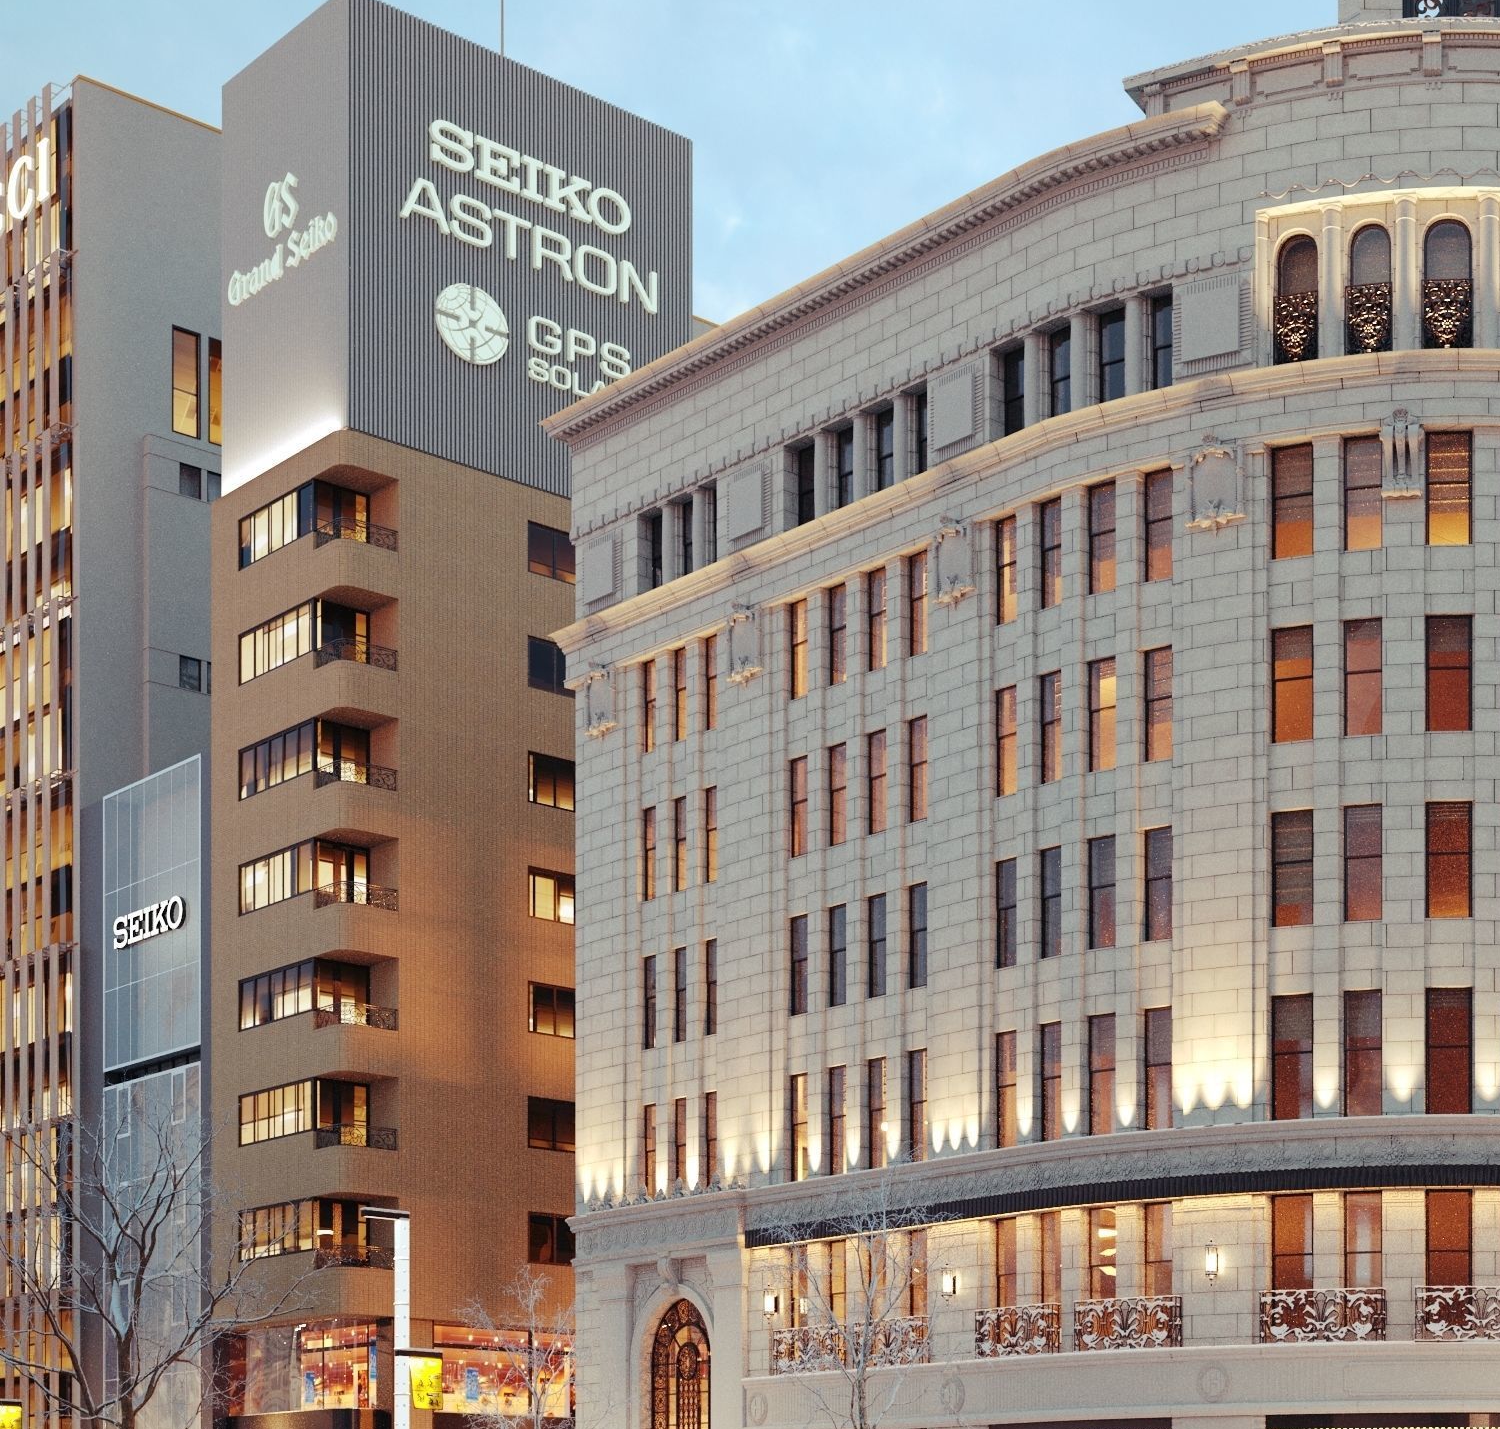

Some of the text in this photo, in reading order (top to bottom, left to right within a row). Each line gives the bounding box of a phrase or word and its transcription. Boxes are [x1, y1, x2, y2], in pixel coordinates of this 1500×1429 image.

[263, 171, 299, 239] GS
[429, 119, 632, 235] SEIKO
[228, 211, 338, 307] Grand Seiko
[400, 177, 658, 316] ASTRON
[527, 315, 631, 379] GPS
[112, 895, 185, 950] SEIKO
